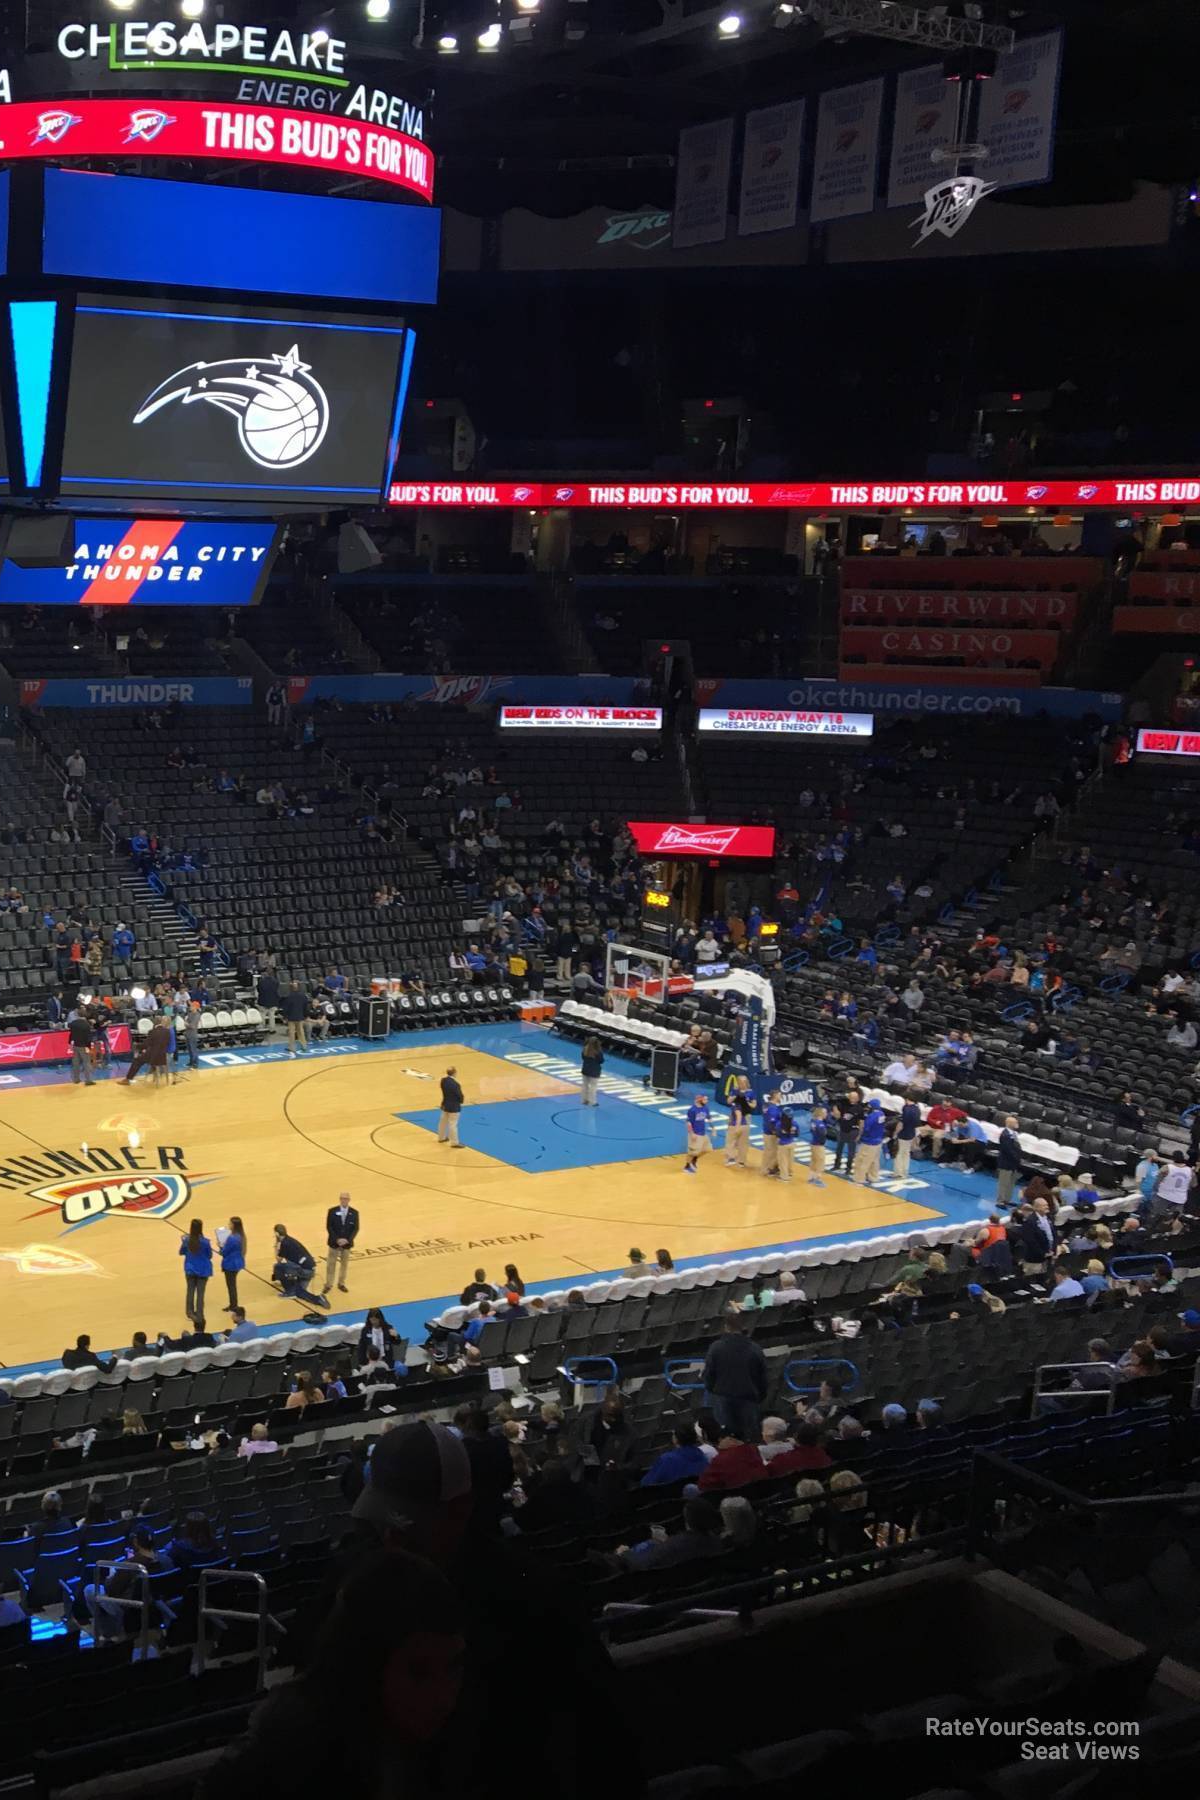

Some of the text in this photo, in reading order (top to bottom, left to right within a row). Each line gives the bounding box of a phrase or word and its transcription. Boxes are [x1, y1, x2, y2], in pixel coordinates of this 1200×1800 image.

[57, 22, 346, 73] CHESAPEAKE
[237, 79, 424, 140] ENERGY ARENA
[201, 110, 428, 187] THIS BUD'S FOR YOU.
[433, 486, 462, 503] FOR
[465, 486, 500, 503] YOU.
[588, 487, 625, 504] THIS
[628, 487, 677, 504] BUD'S
[681, 487, 712, 504] FOR
[715, 487, 754, 504] YOU.
[830, 486, 868, 503] THIS
[872, 486, 925, 503] BUD'S
[928, 485, 963, 503] FOR
[966, 484, 1008, 502] YOU.
[1115, 483, 1156, 501] THIS
[74, 543, 265, 562] AHOMA CITY
[64, 565, 204, 582] THUNDER
[850, 595, 1067, 617] RIVERWIND
[881, 632, 1013, 653] CASINO
[23, 681, 41, 692] 117
[86, 684, 194, 703] THUNDER
[788, 684, 1022, 714] okcthunder.com
[565, 708, 584, 719] ON
[587, 709, 610, 719] THE
[729, 711, 843, 724] SATURDAY MAY 18
[713, 721, 857, 733] CHESAPEAKE ENERGY ARENA
[662, 831, 729, 845] Budweiser
[62, 1177, 159, 1224] OKC
[468, 1232, 544, 1249] ARENA
